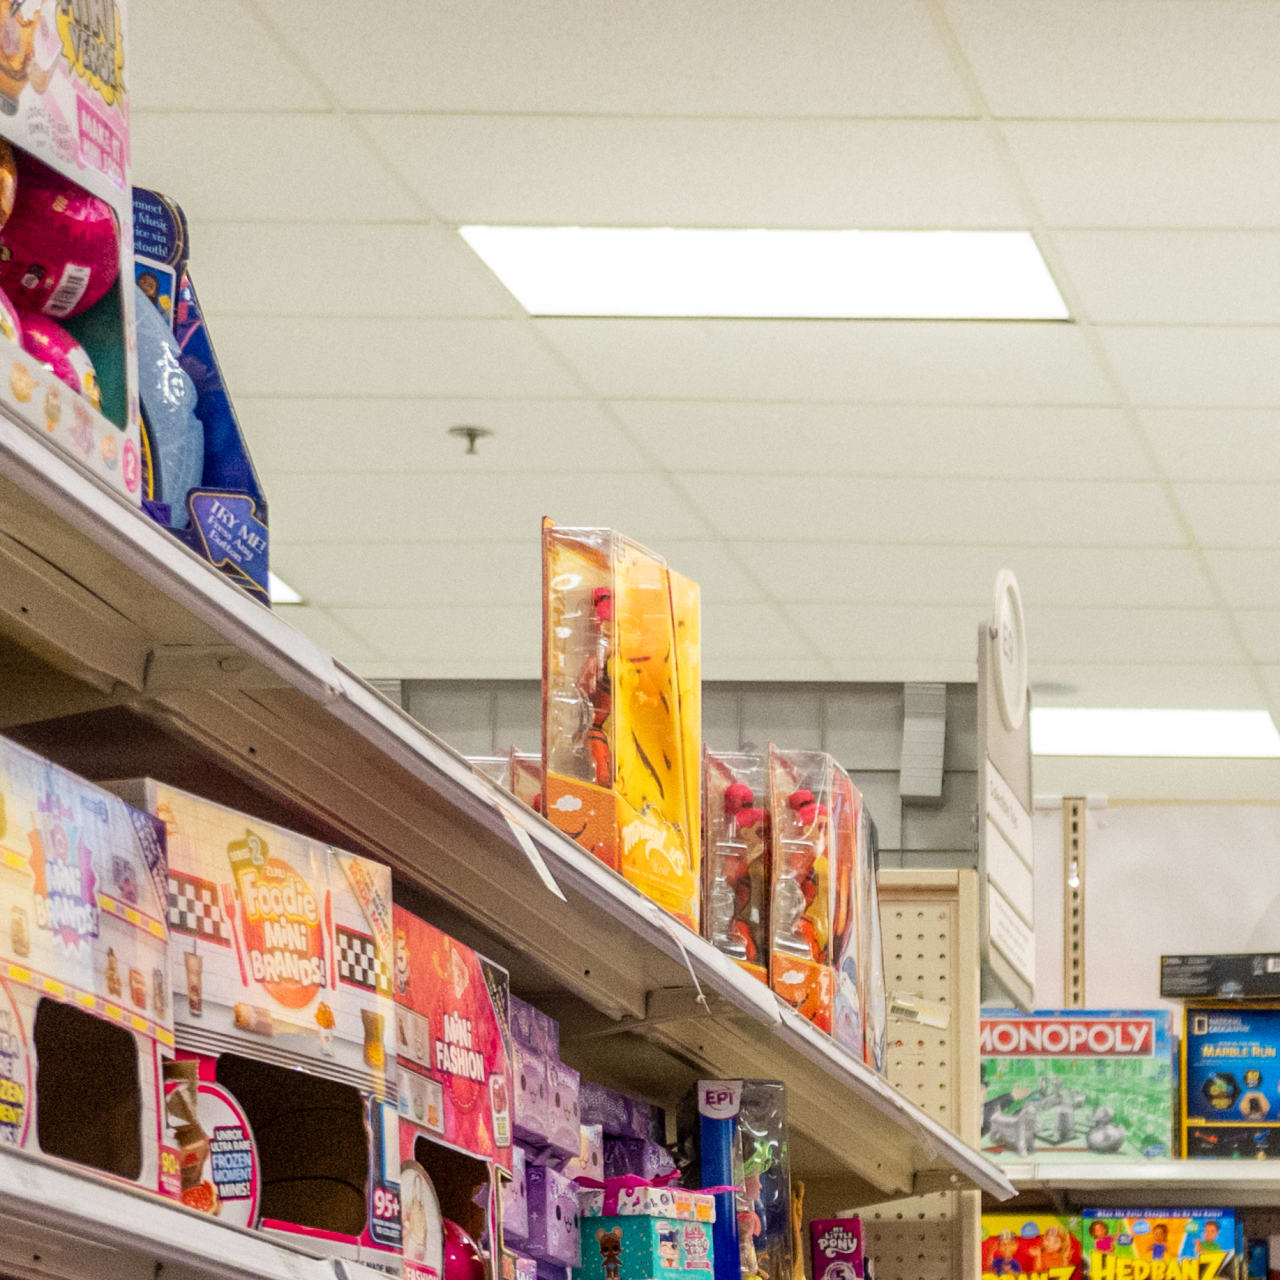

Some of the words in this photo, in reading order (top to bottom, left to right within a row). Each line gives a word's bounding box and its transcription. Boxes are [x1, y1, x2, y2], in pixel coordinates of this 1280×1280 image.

[209, 498, 240, 530] TRY
[238, 524, 267, 555] ME!
[240, 871, 320, 921] Foodie
[251, 950, 327, 988] BRANDS!
[980, 1024, 1151, 1054] MONOPOLY
[1202, 1046, 1249, 1058] MARBLE
[1252, 1046, 1277, 1058] RUN
[435, 1039, 485, 1082] FASHION
[214, 1128, 244, 1141] UNBOX
[212, 1152, 251, 1168] FROZEN
[219, 1183, 251, 1198] MINIS!
[373, 1190, 401, 1219] 95+
[817, 1236, 858, 1259] PONY
